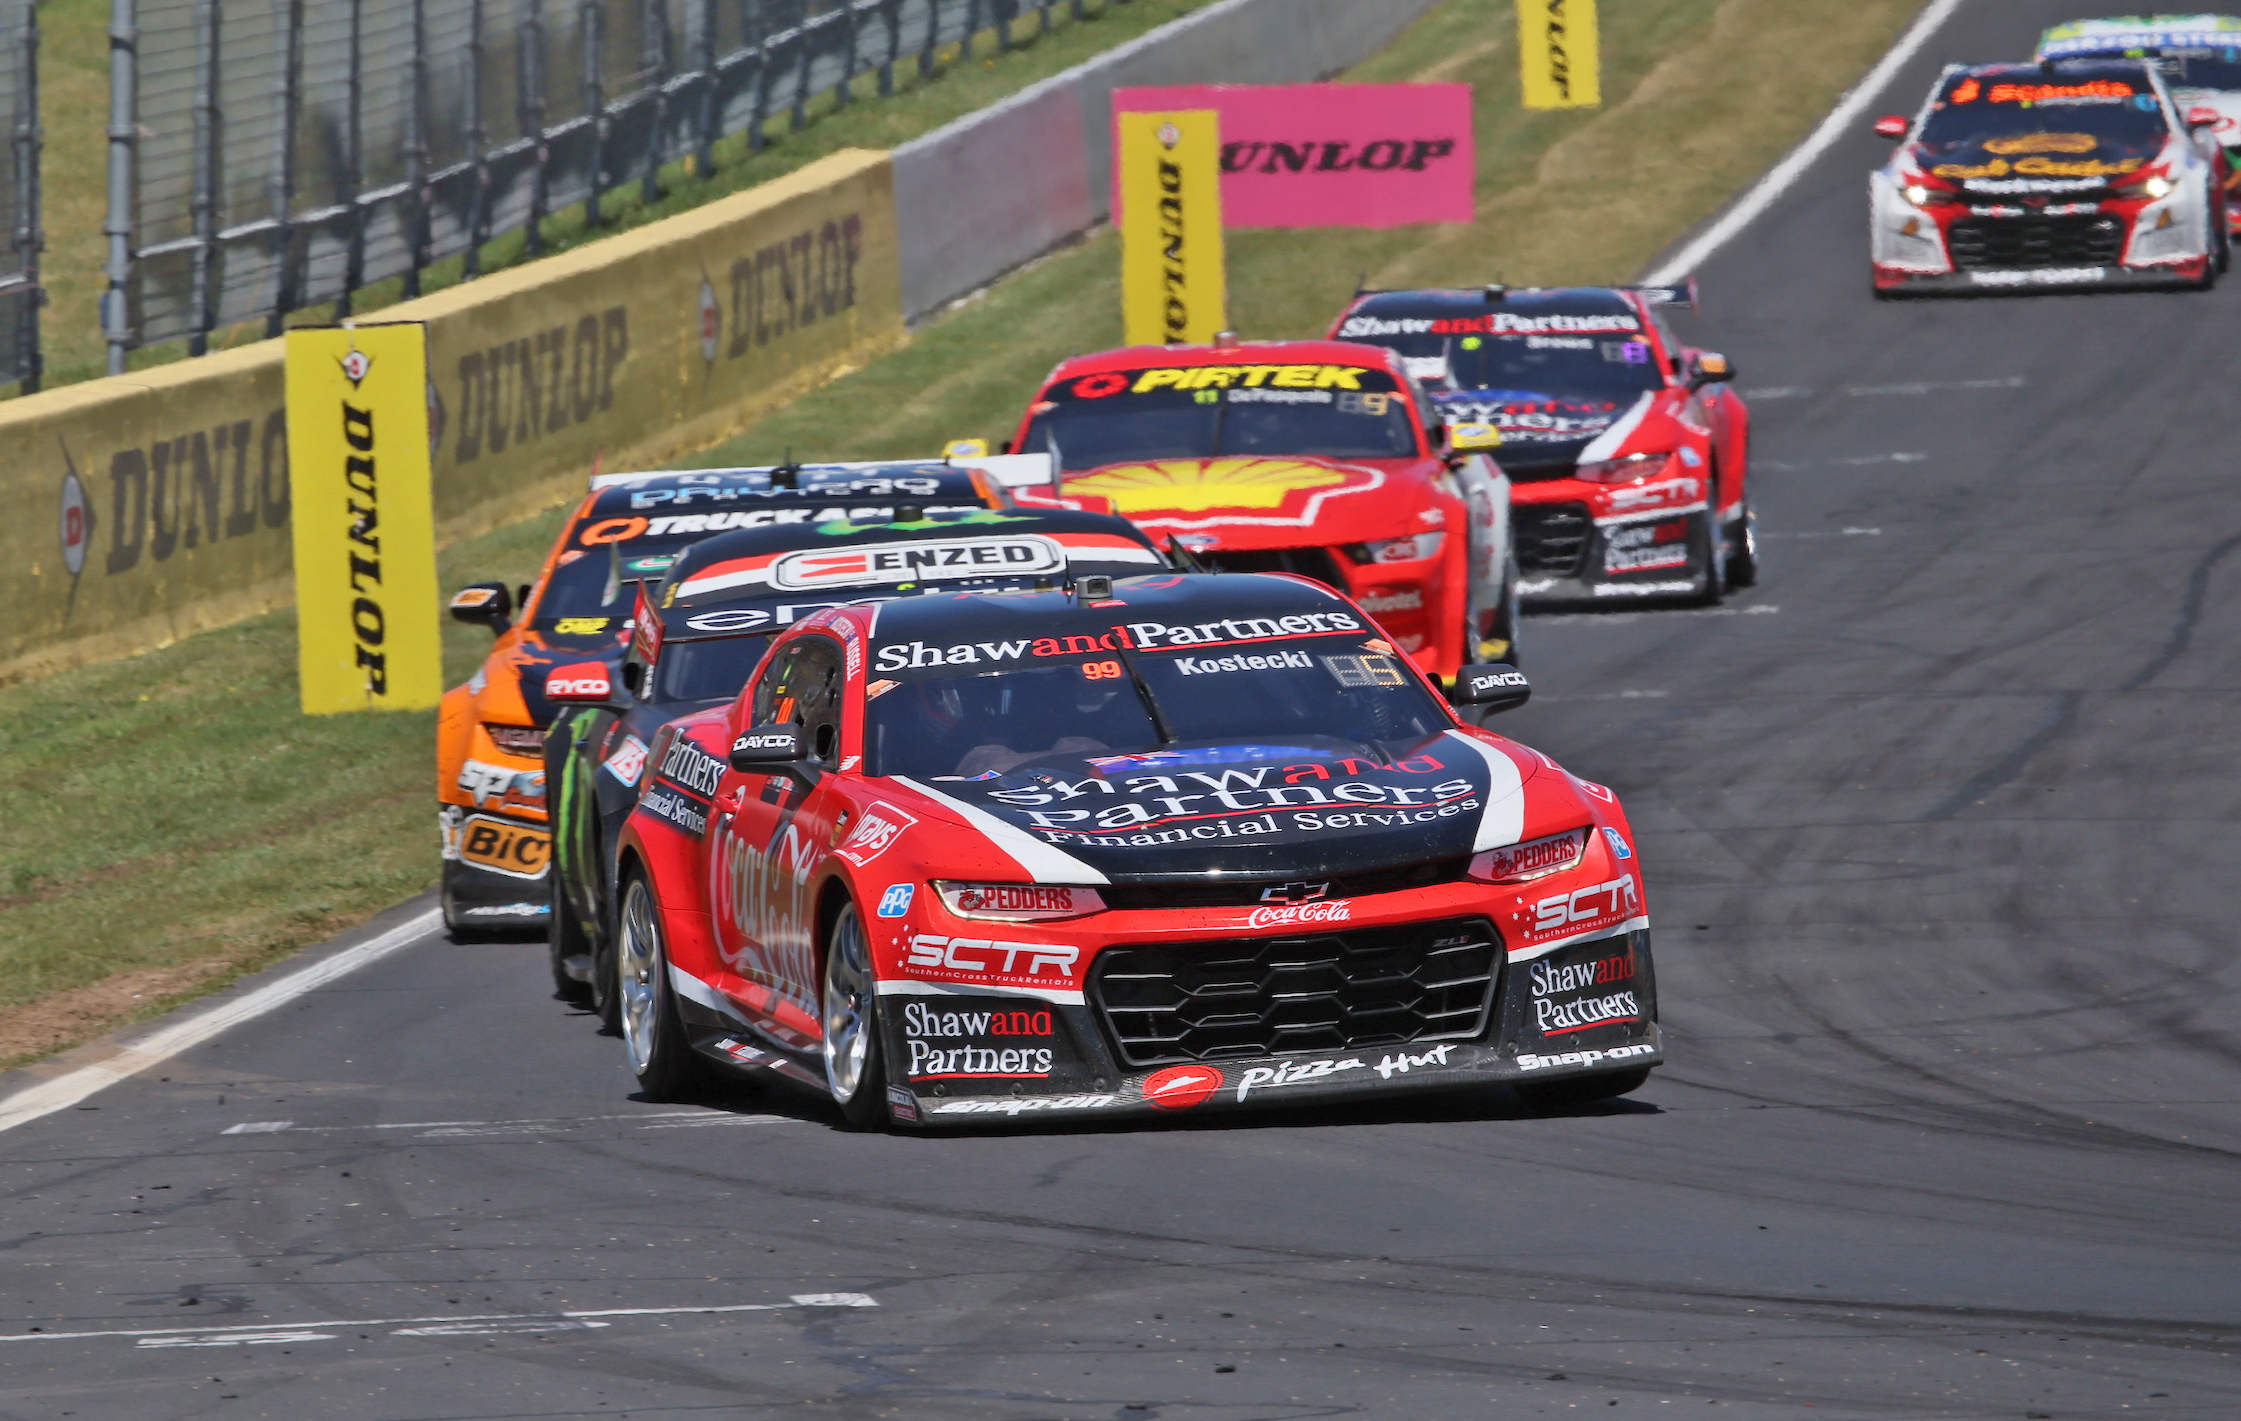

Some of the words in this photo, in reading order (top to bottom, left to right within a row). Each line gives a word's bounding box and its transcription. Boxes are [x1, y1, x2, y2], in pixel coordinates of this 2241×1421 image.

[1221, 138, 1455, 174] UNLOP
[1159, 159, 1189, 344] DUNLO
[727, 212, 862, 360] DUNLOP
[456, 305, 627, 464] DUNLOP
[1130, 364, 1369, 394] PIRTEK
[107, 408, 291, 576] DUNLO
[645, 506, 982, 536] TRUCKAS
[341, 399, 388, 698] DUNLOP
[874, 544, 1035, 571] ENZED
[1082, 660, 1122, 681] 99
[1174, 650, 1314, 677] Kostecki
[1470, 671, 1528, 690] DAYCO
[546, 679, 610, 696] RYCO
[733, 734, 792, 752] DAYCO
[659, 728, 727, 797] Partners
[671, 799, 707, 835] Services
[1016, 778, 1477, 830] Partners
[1039, 814, 1284, 847] Financial
[1295, 797, 1480, 831] Services
[1513, 834, 1577, 873] PEDDERS
[880, 887, 913, 913] PPG
[983, 886, 1072, 911] PEDDERS
[1248, 901, 1352, 929] Coca-Cola
[1534, 873, 1638, 931] SCTR
[907, 934, 1080, 977] SCTR
[904, 966, 1075, 987] SouthernCrossTruckRentals
[1533, 990, 1640, 1032] Partners
[907, 1039, 1053, 1076] Partners
[1372, 1045, 1458, 1080] Hut
